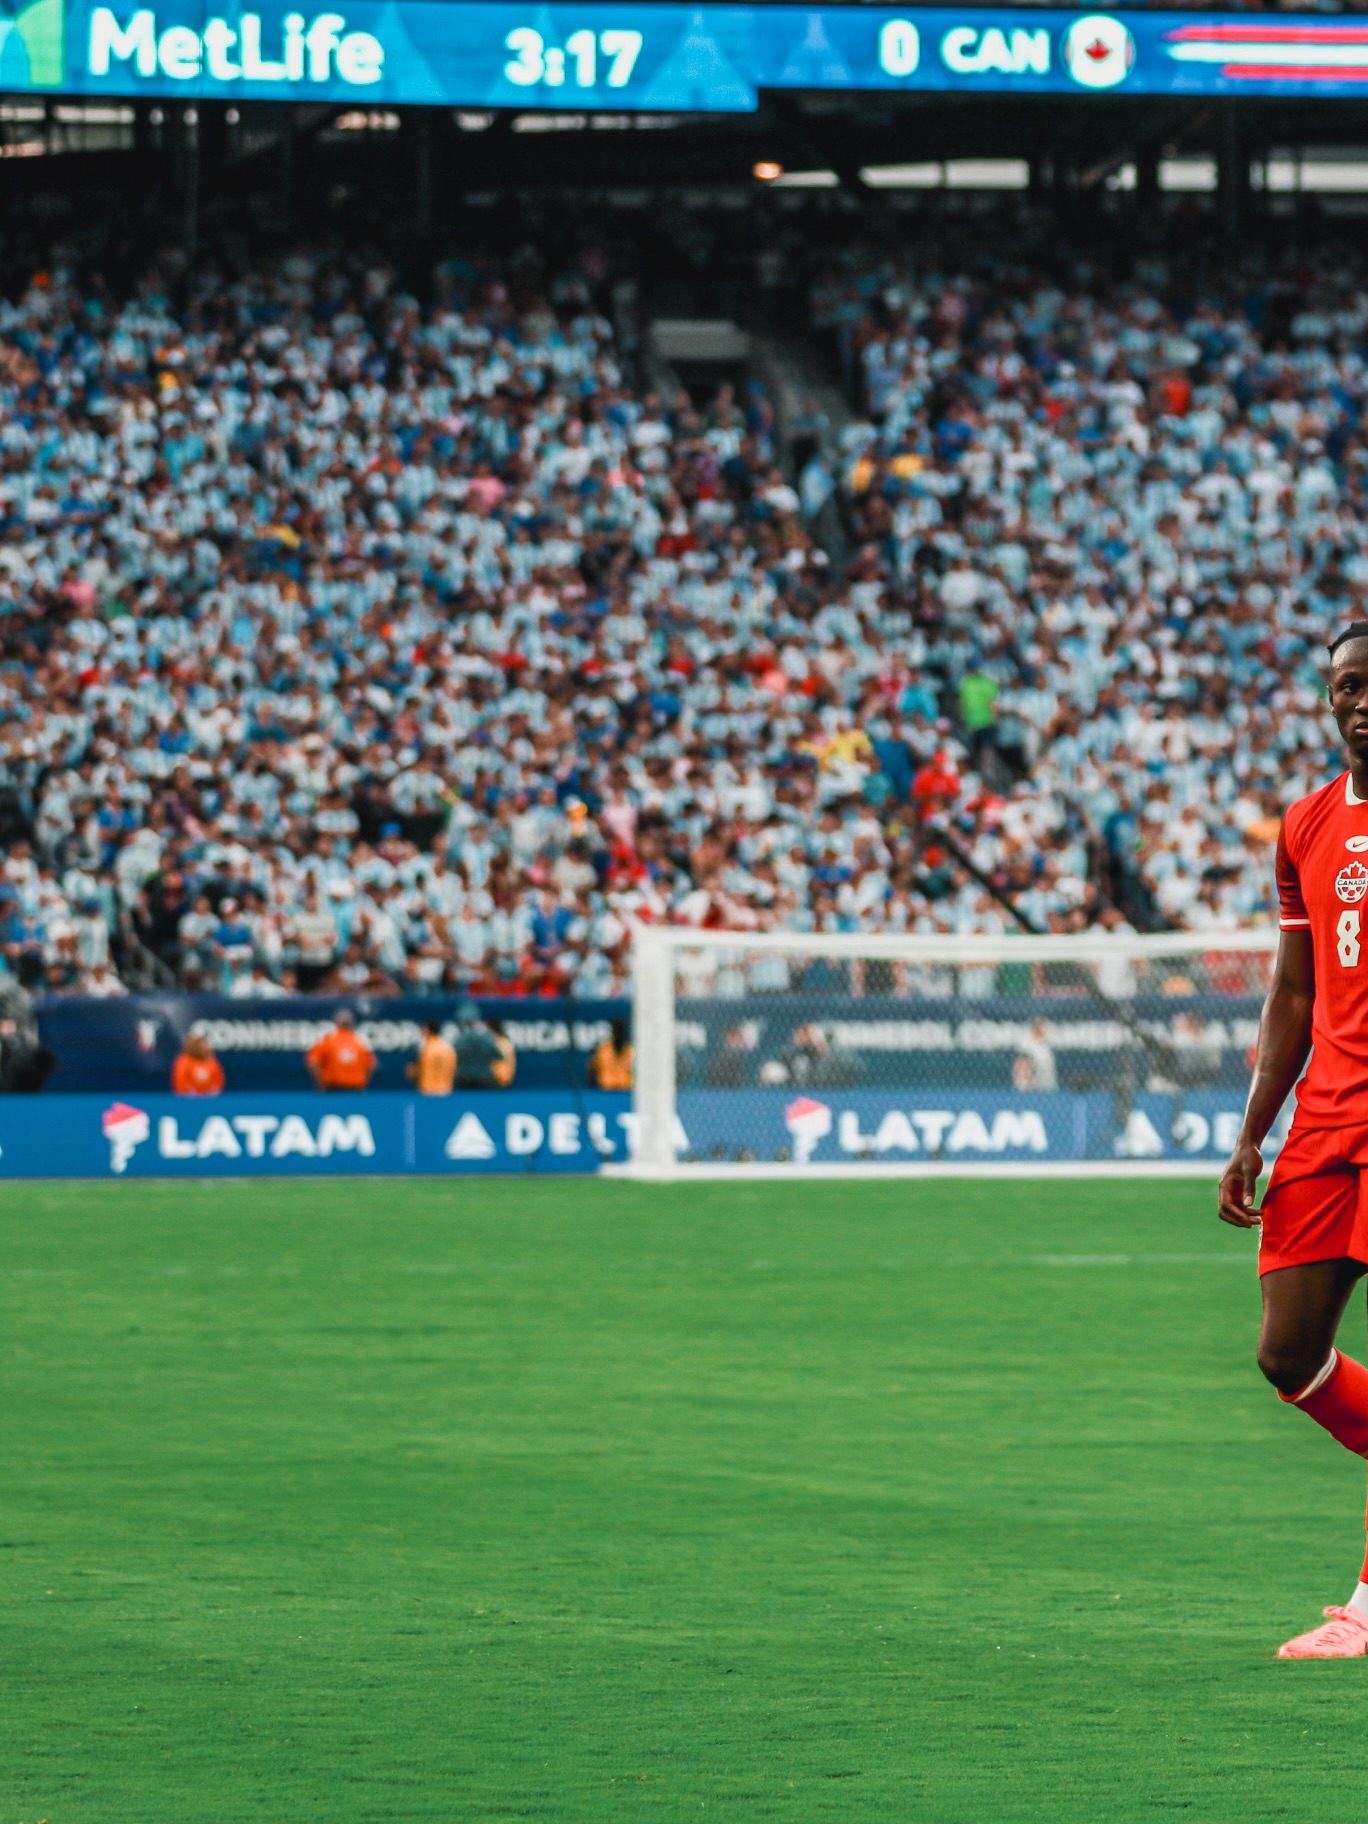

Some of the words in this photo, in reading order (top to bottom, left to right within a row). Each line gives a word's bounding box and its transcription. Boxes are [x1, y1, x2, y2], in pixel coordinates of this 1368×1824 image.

[89, 6, 385, 85] MetLife
[504, 26, 644, 87] 3:17
[940, 26, 1051, 76] CAN
[1337, 879, 1367, 887] CANADA
[1336, 909, 1361, 967] 8
[159, 1113, 376, 1159] LATAM
[838, 1110, 1049, 1153] LATAM
